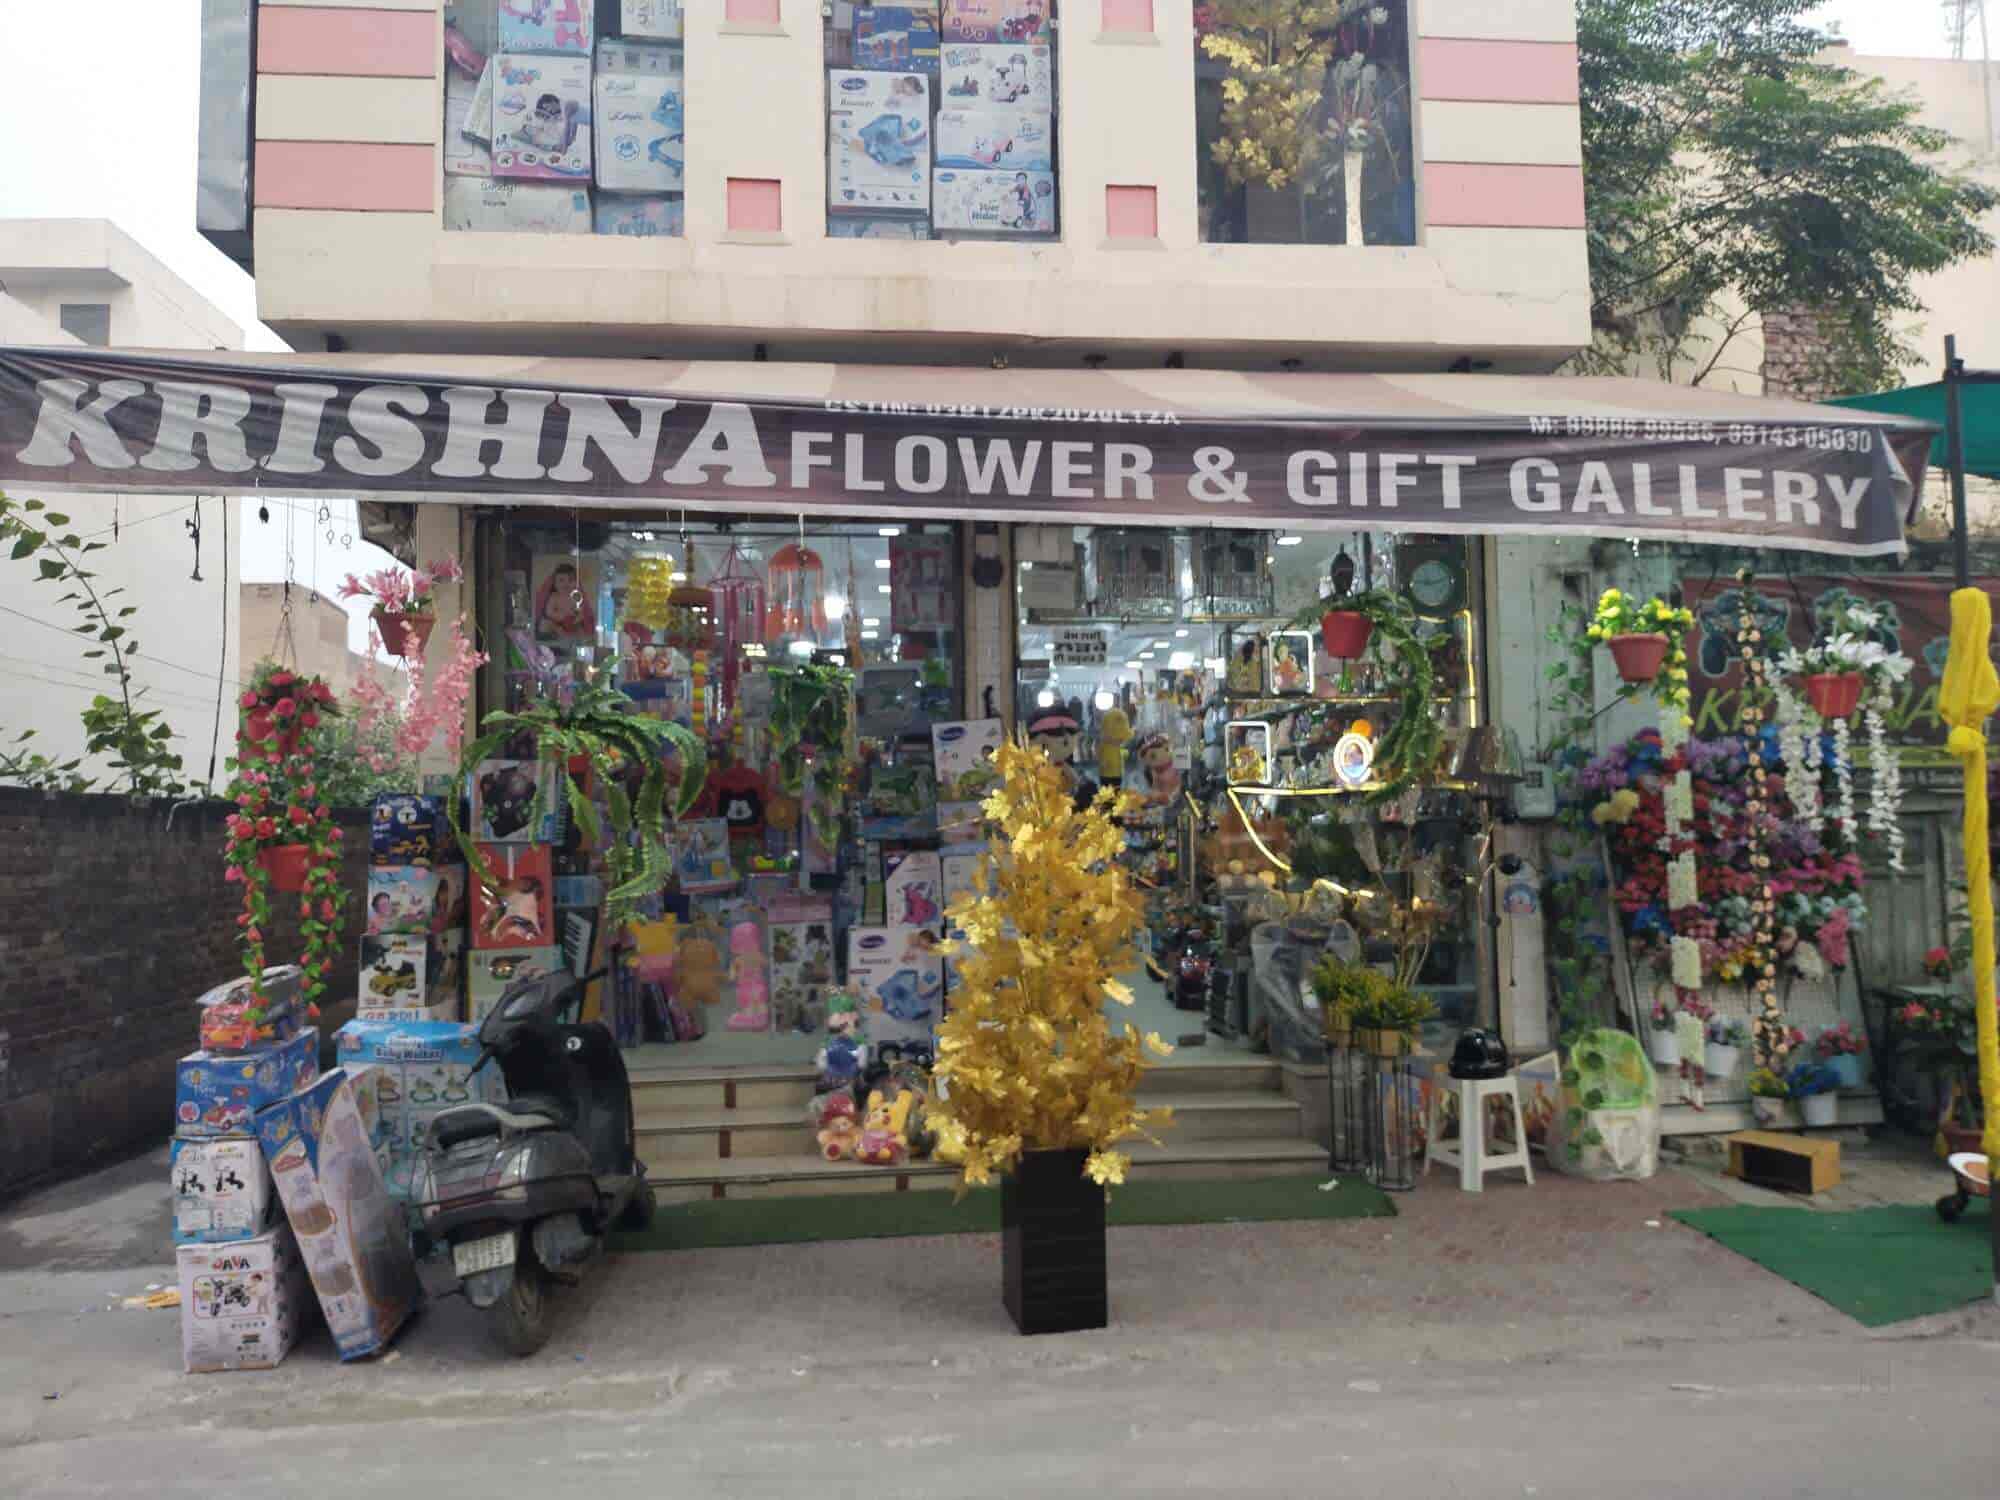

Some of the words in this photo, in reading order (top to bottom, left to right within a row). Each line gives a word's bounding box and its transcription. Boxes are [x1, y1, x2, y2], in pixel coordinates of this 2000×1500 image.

[15, 378, 777, 487] KRISHNA
[790, 430, 1154, 501] FLOWER
[1186, 446, 1253, 503] &
[1286, 449, 1477, 510] GIFT
[1508, 457, 1873, 530] GALLERY
